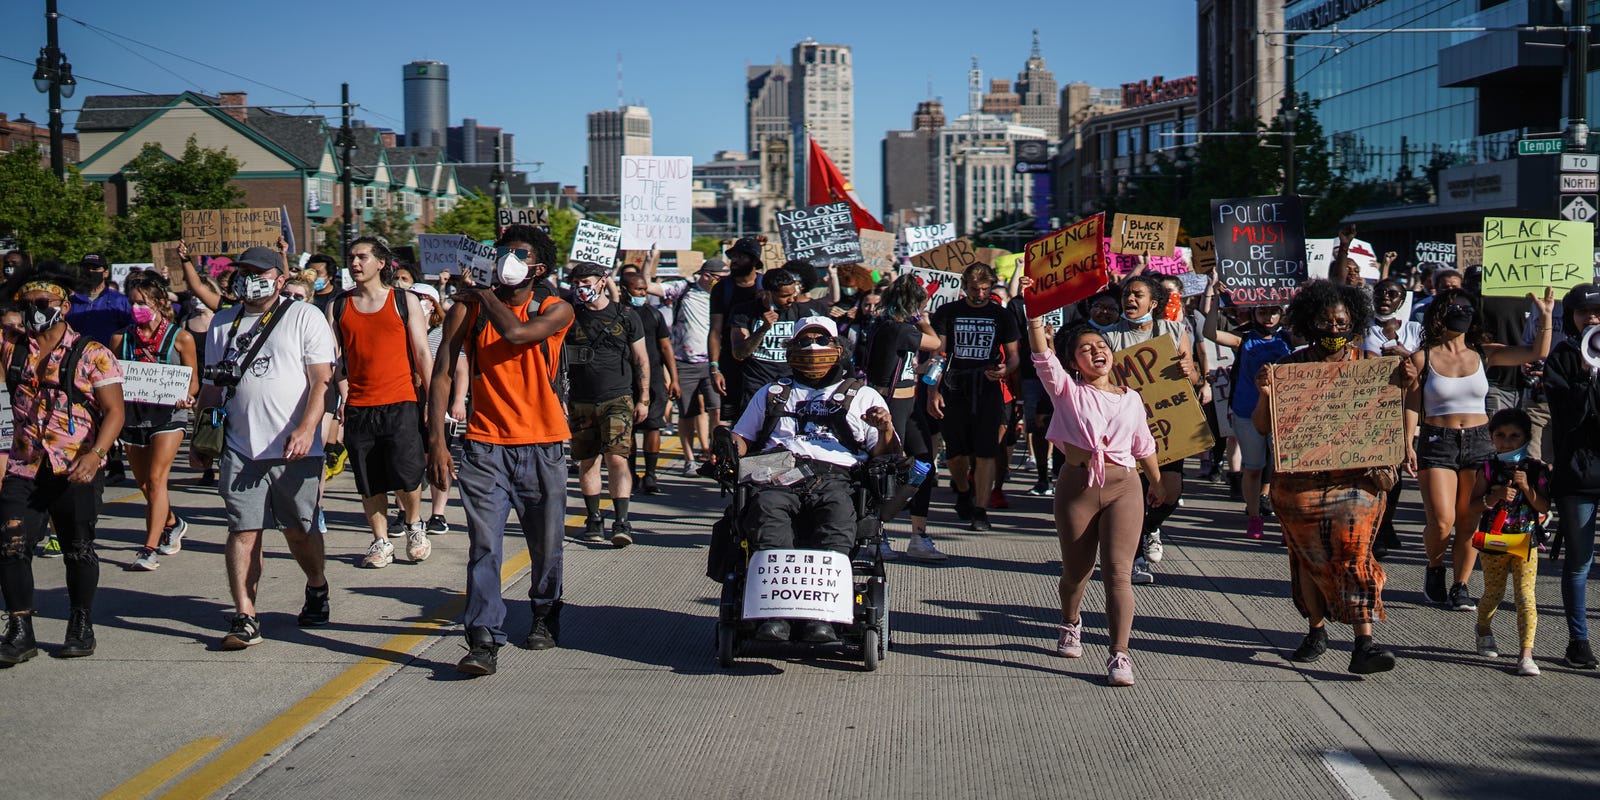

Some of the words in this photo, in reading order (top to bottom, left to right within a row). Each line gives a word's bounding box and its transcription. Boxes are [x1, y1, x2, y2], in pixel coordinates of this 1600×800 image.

[1523, 140, 1561, 152] Temple
[624, 158, 689, 179] DEFUND
[1573, 158, 1587, 168] TO
[638, 179, 667, 196] THE
[1563, 177, 1596, 189] NORTH
[624, 194, 677, 211] POLICE
[183, 210, 212, 225] BLACK
[500, 209, 547, 226] BLACK
[778, 210, 808, 225] NO
[814, 202, 850, 218] ONE
[1220, 202, 1288, 224] POLICE
[1572, 208, 1587, 220] 10
[791, 221, 806, 229] IS
[811, 213, 848, 226] FREE
[1130, 220, 1164, 231] BLACK
[183, 225, 217, 238] LIVES
[791, 224, 843, 239] UNTIL
[913, 225, 948, 239] STOP
[1127, 231, 1160, 241] LIVES
[1232, 225, 1285, 245] MUST
[1485, 220, 1568, 242] BLACK
[423, 238, 440, 249] NO
[457, 237, 498, 261] ABOLISH
[1029, 220, 1096, 263] SILENCE
[1124, 241, 1165, 251] MATTER
[1416, 242, 1456, 254] ARREST
[576, 250, 612, 266] POLICE
[585, 246, 600, 255] NO
[786, 249, 815, 261] CAN
[919, 240, 976, 271] ACAB
[1250, 245, 1274, 260] BE
[1416, 251, 1456, 263] VIOLENT
[1514, 243, 1560, 260] LIVES
[1049, 250, 1065, 269] IS
[926, 271, 960, 289] STAND
[1030, 253, 1102, 295] VIOLENCE
[1483, 262, 1584, 283] MATTER
[1226, 277, 1256, 287] OWN
[1260, 278, 1276, 287] UP
[1279, 278, 1296, 287] TO
[955, 332, 993, 346] LIVES
[955, 347, 989, 359] MATTER
[758, 565, 842, 577] DISABILITY
[771, 589, 840, 603] POVERTY
